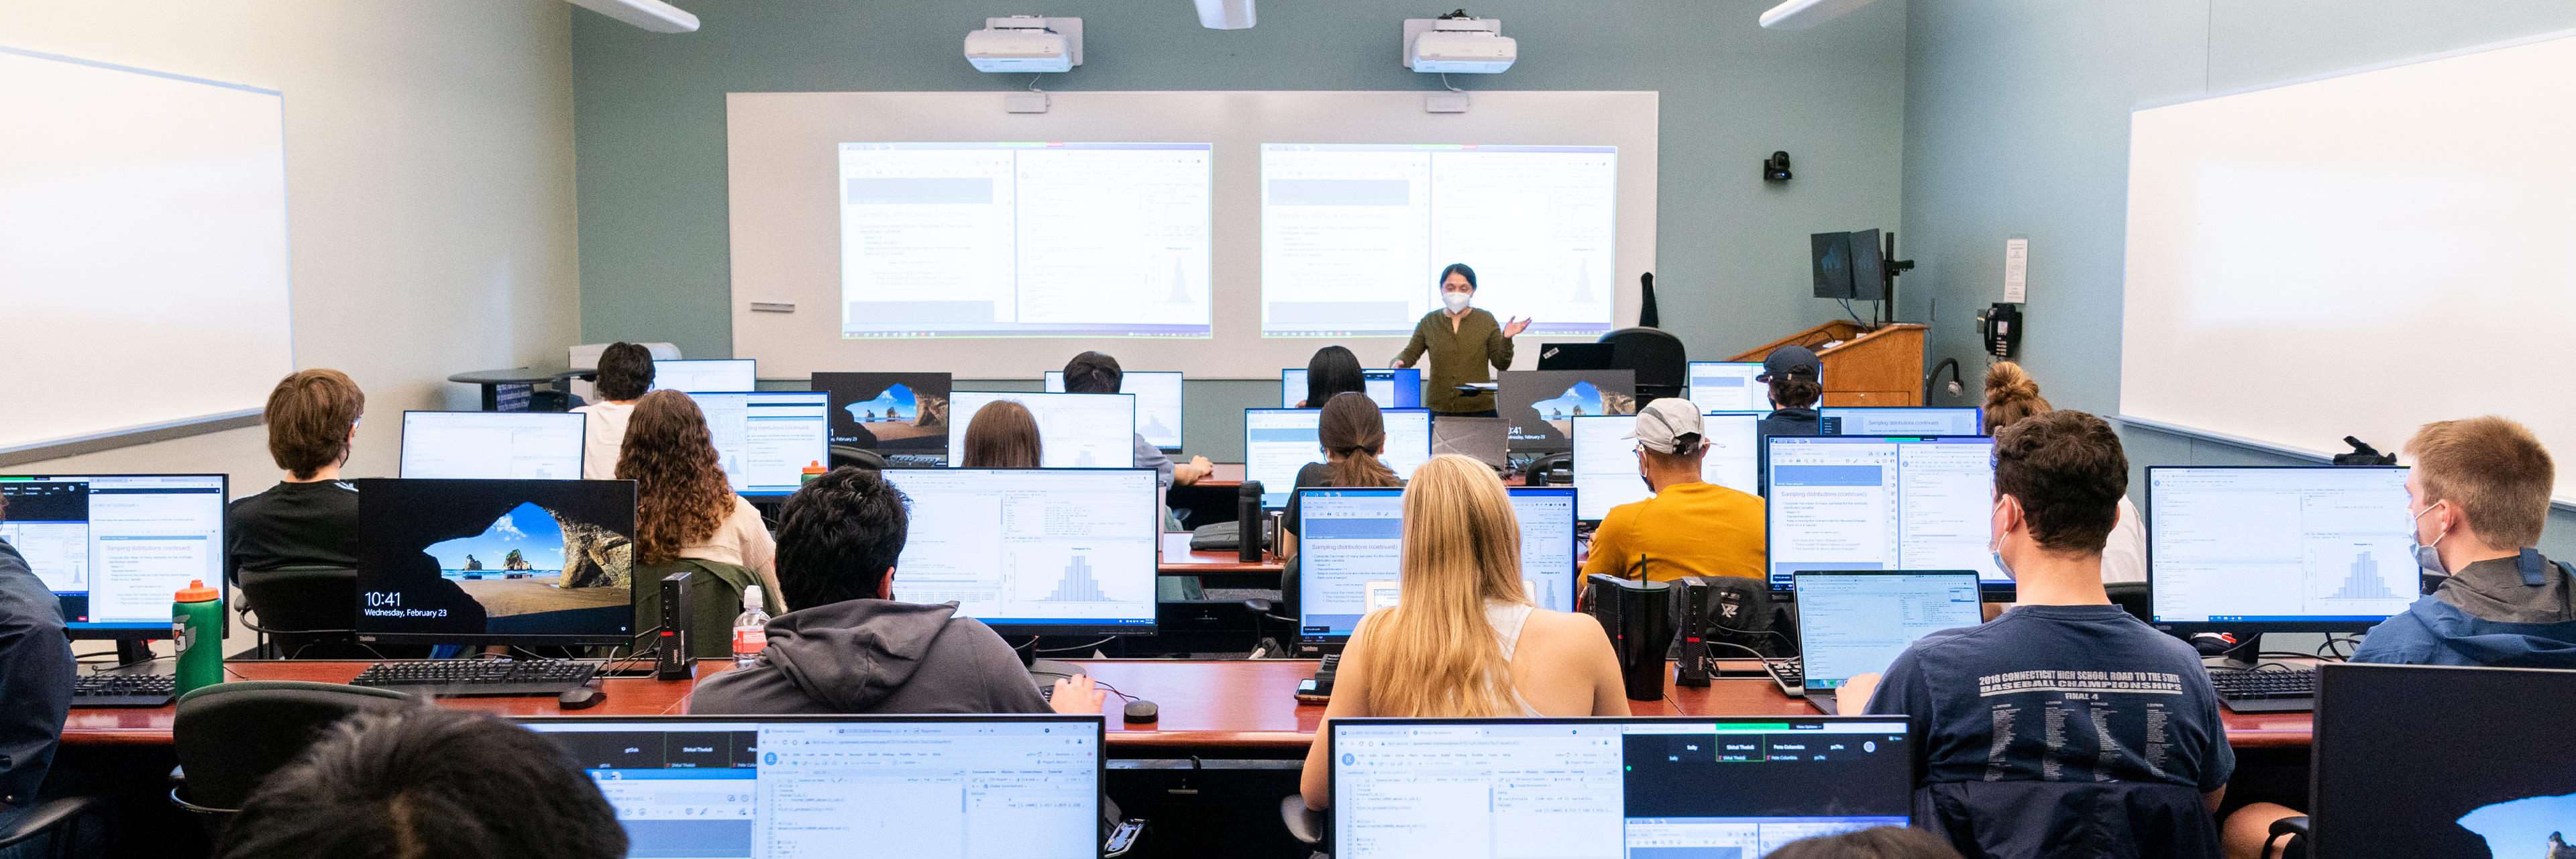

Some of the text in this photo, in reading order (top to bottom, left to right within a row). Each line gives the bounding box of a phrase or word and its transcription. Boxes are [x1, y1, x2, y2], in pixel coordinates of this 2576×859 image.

[365, 592, 400, 607] 10:41
[365, 609, 405, 618] Wednesday,
[407, 609, 437, 618] February
[1979, 670, 2180, 685] 2018 CONNECTICUT HIGH SCHOOL ROAD TO THE STATE
[1980, 680, 2182, 693] BASEBALL CHAMPIONSHIPS
